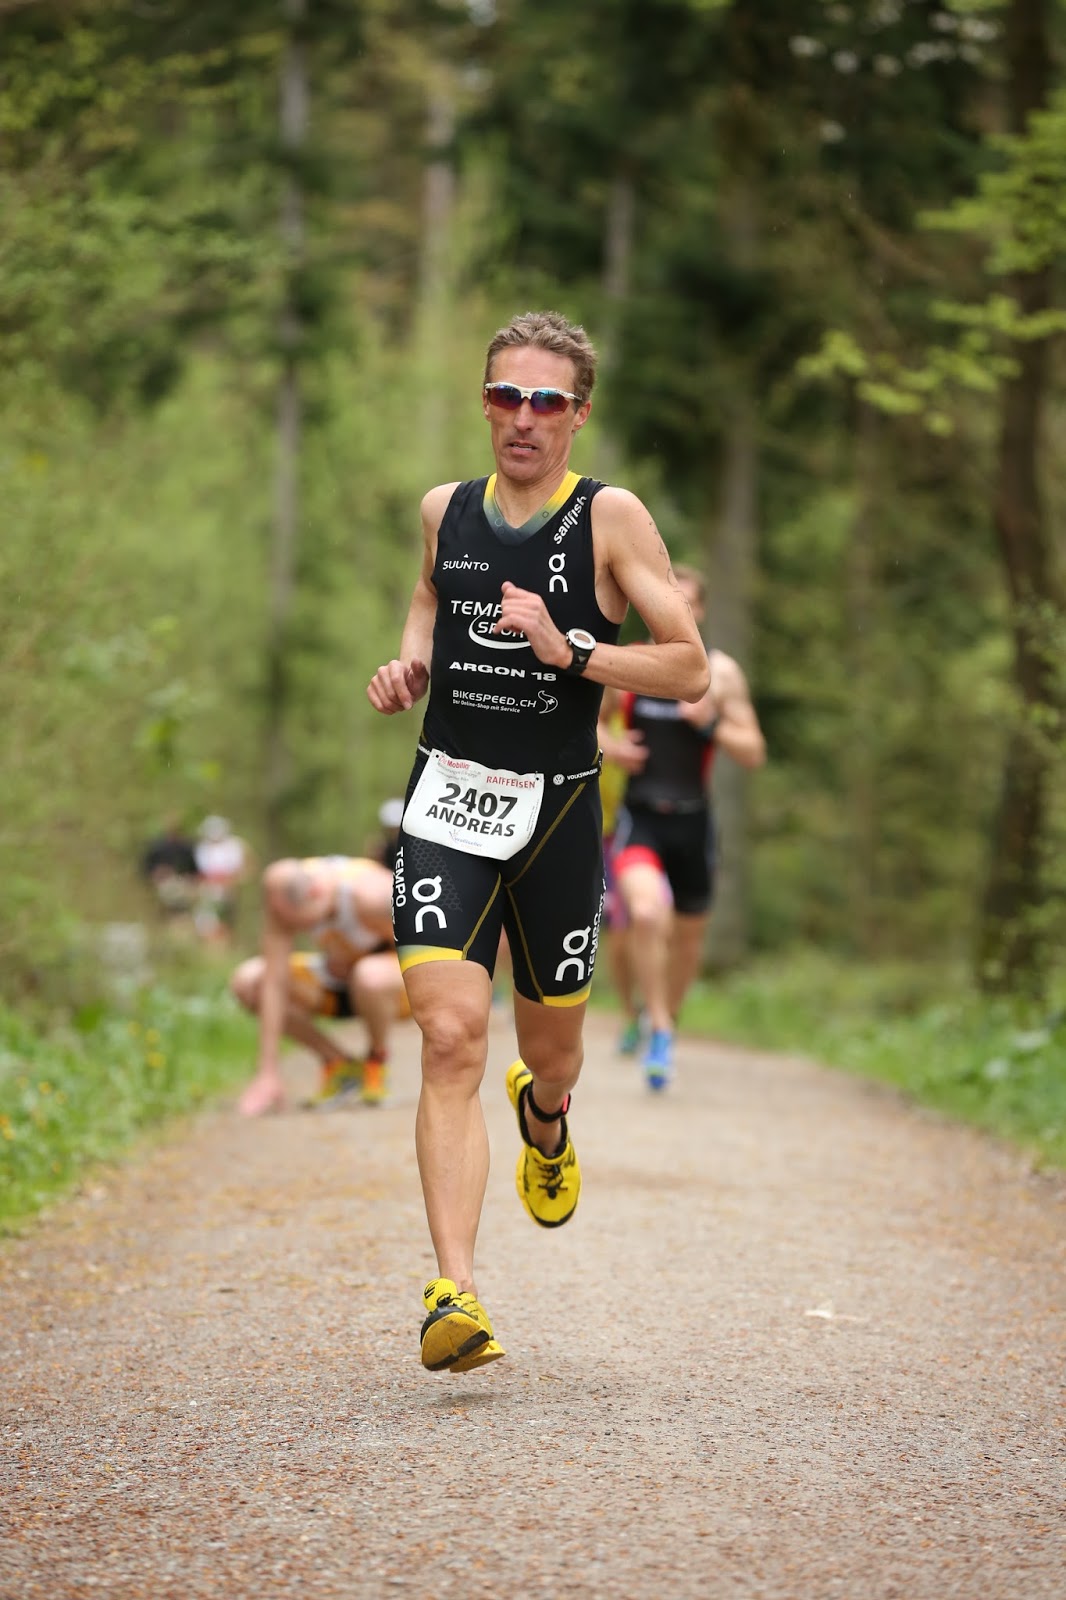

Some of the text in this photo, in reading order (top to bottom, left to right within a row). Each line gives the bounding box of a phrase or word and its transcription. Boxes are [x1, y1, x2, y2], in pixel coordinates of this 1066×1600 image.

[553, 495, 588, 545] sailfish
[442, 560, 490, 572] SUUNTO
[450, 600, 503, 618] TEMP
[449, 661, 557, 682] ARGON 18
[452, 689, 537, 708] BIKESPEED.CH
[486, 775, 536, 789] RAIFFEISEN
[437, 782, 518, 820] 2407
[425, 804, 515, 837] ANDREAS
[395, 846, 407, 908] TEMPO
